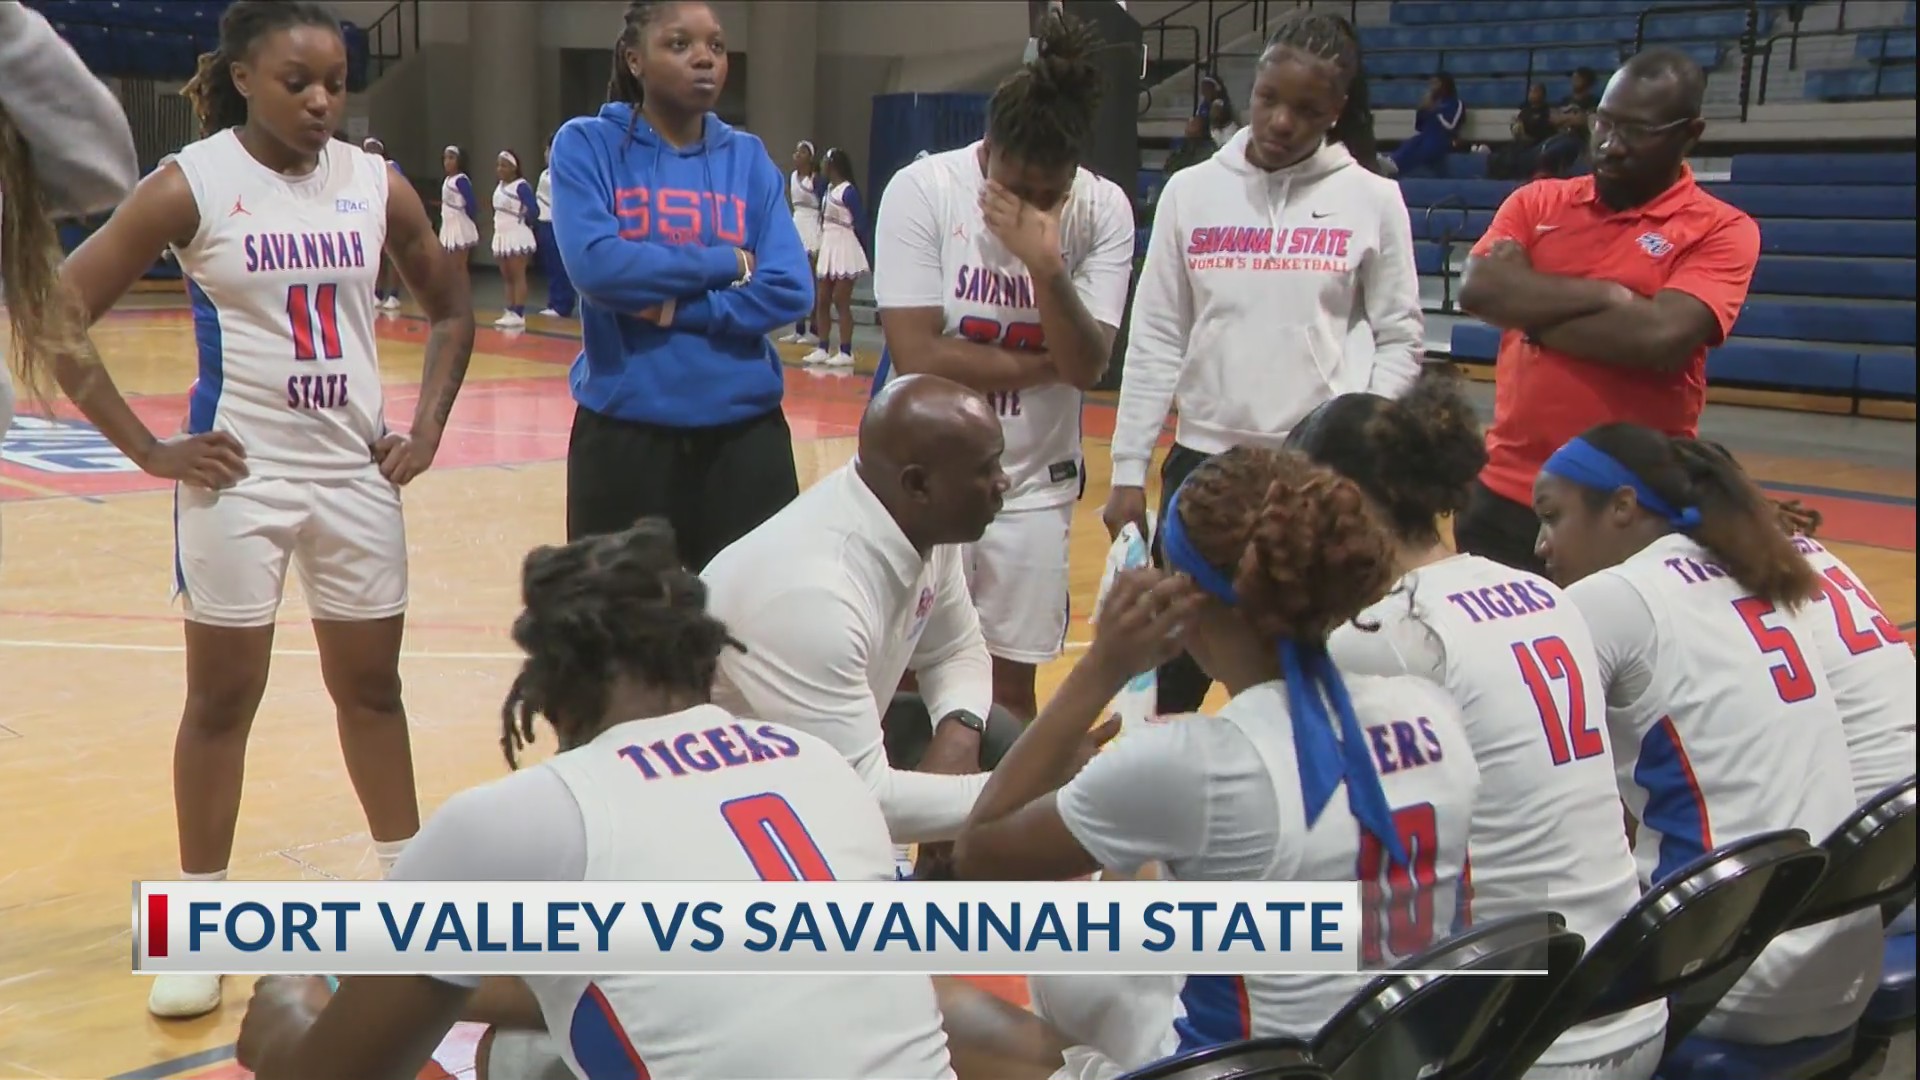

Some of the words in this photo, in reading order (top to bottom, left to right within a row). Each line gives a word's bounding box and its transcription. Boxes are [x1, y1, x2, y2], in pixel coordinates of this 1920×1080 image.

[615, 187, 746, 245] SSU
[244, 231, 366, 272] SAVANNAH
[1188, 256, 1247, 270] WOMEN'S
[1253, 258, 1350, 273] BASKETBALL
[1288, 227, 1353, 257] STATE
[955, 264, 1037, 309] SAVANN
[286, 283, 343, 361] 11
[287, 374, 349, 410] STATE
[1446, 579, 1557, 623] TIGERS
[1731, 595, 1817, 704] 5
[1510, 636, 1604, 766] 12
[617, 723, 801, 780] TIGERS
[1366, 716, 1443, 776] ERS
